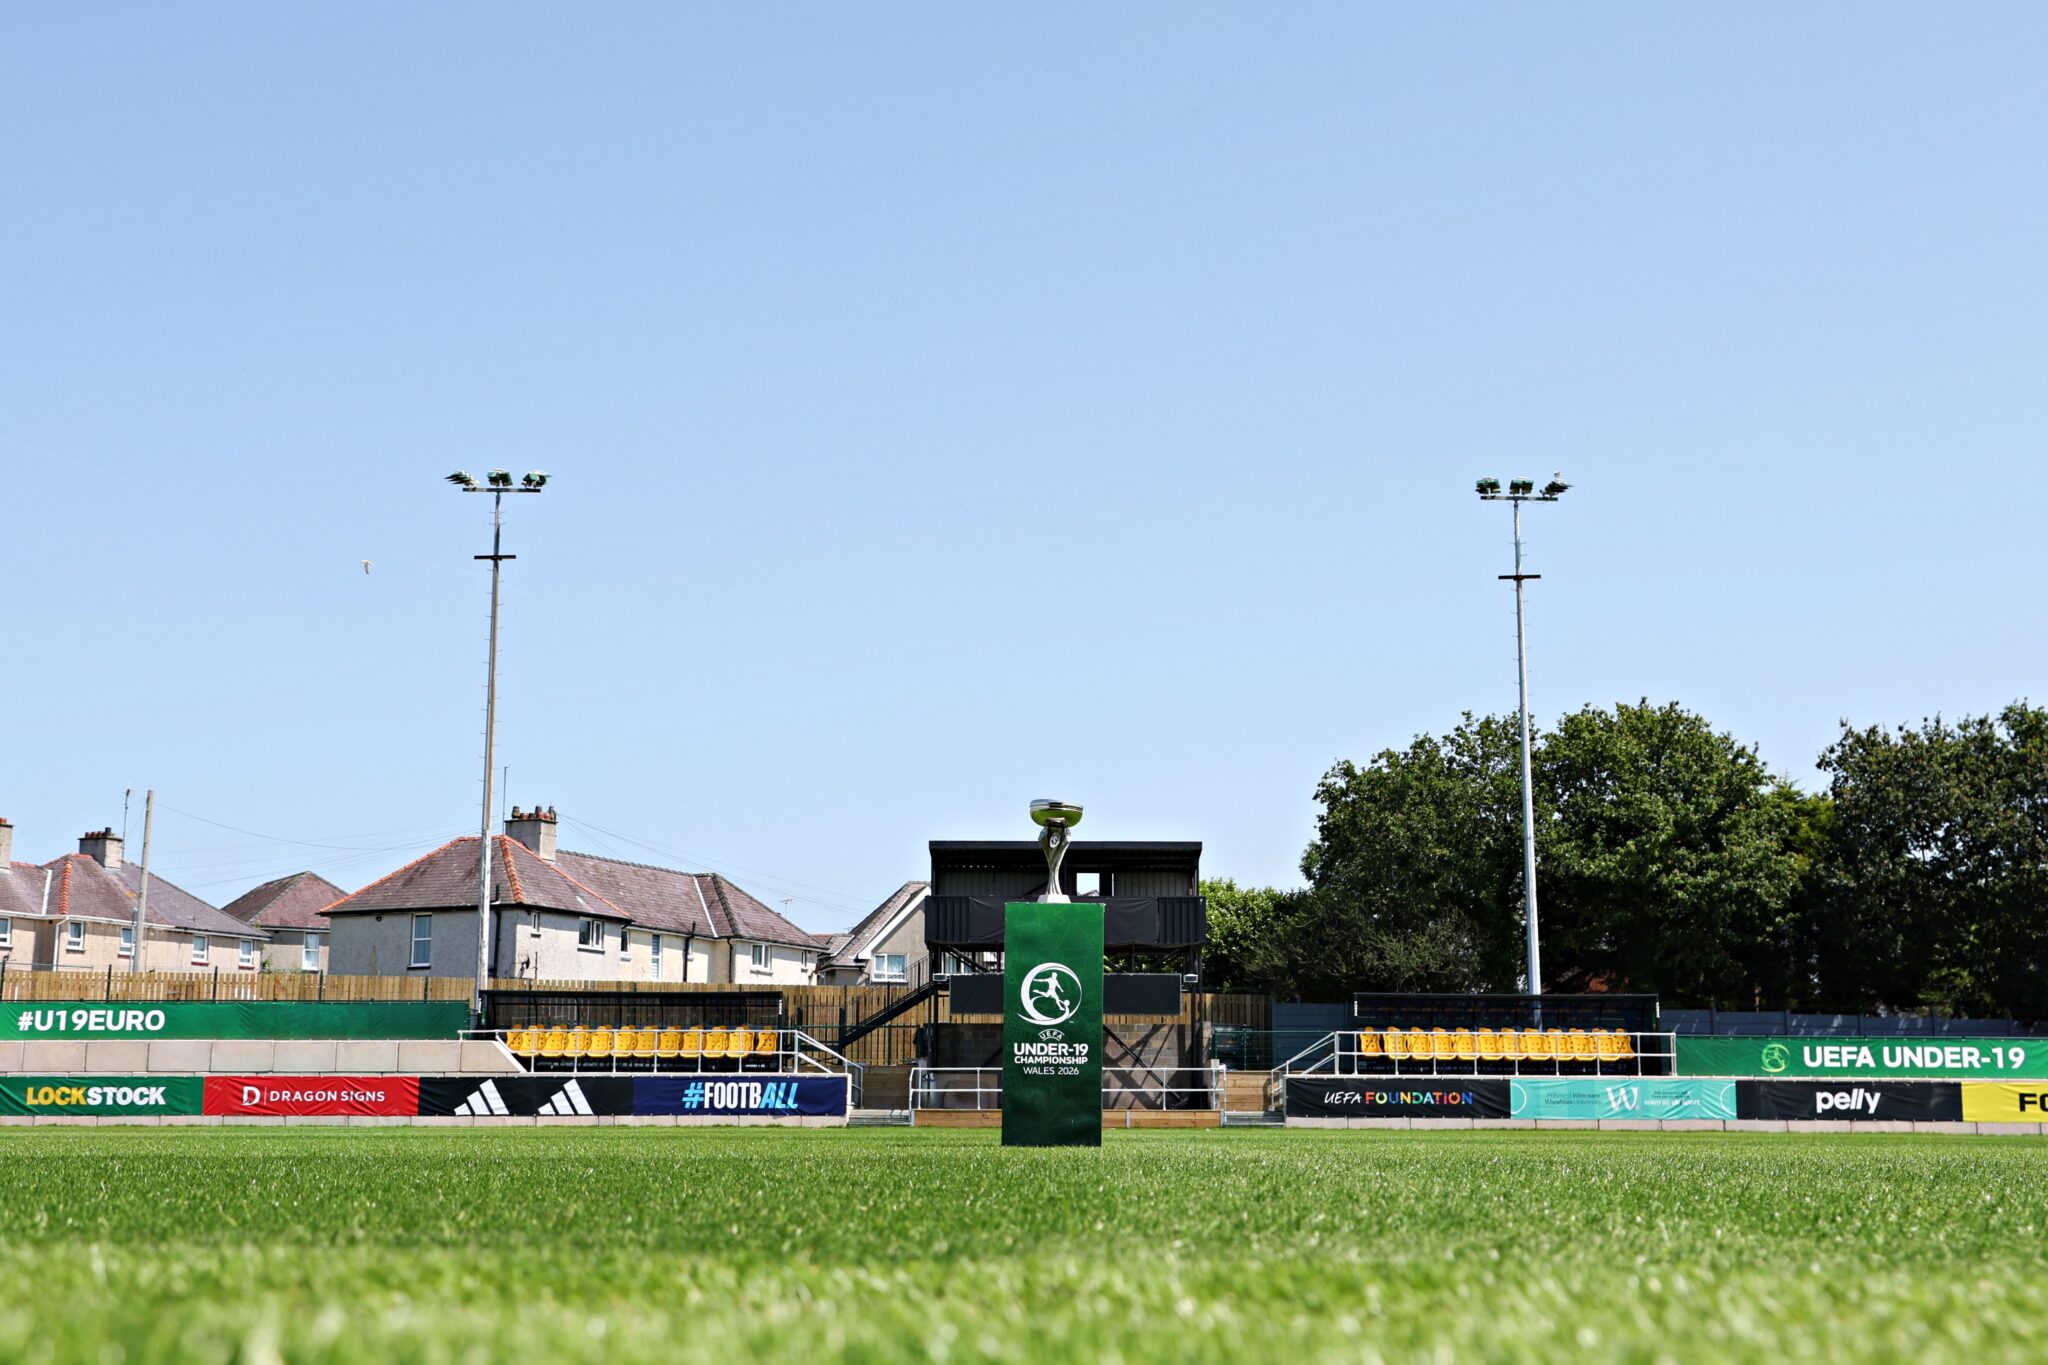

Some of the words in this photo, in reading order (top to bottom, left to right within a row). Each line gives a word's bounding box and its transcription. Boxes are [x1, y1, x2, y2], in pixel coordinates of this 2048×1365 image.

[18, 1009, 165, 1031] #U19EURO
[1040, 1030, 1063, 1041] UEFA
[1014, 1043, 1089, 1056] UNDER-19
[1014, 1056, 1089, 1065] CHAMPIONSHIP
[1803, 1046, 1876, 1068] UEFA
[1883, 1046, 2026, 1069] UNDER-19
[1023, 1066, 1056, 1075] WALES
[1057, 1066, 1080, 1076] 2026
[269, 1090, 338, 1102] DRAGON
[340, 1090, 385, 1102] SIGNS
[682, 1081, 799, 1110] #FOOTBALL
[1323, 1091, 1363, 1105] UEFA
[1365, 1091, 1473, 1105] FOUNDATION
[1815, 1088, 1881, 1114] pelly
